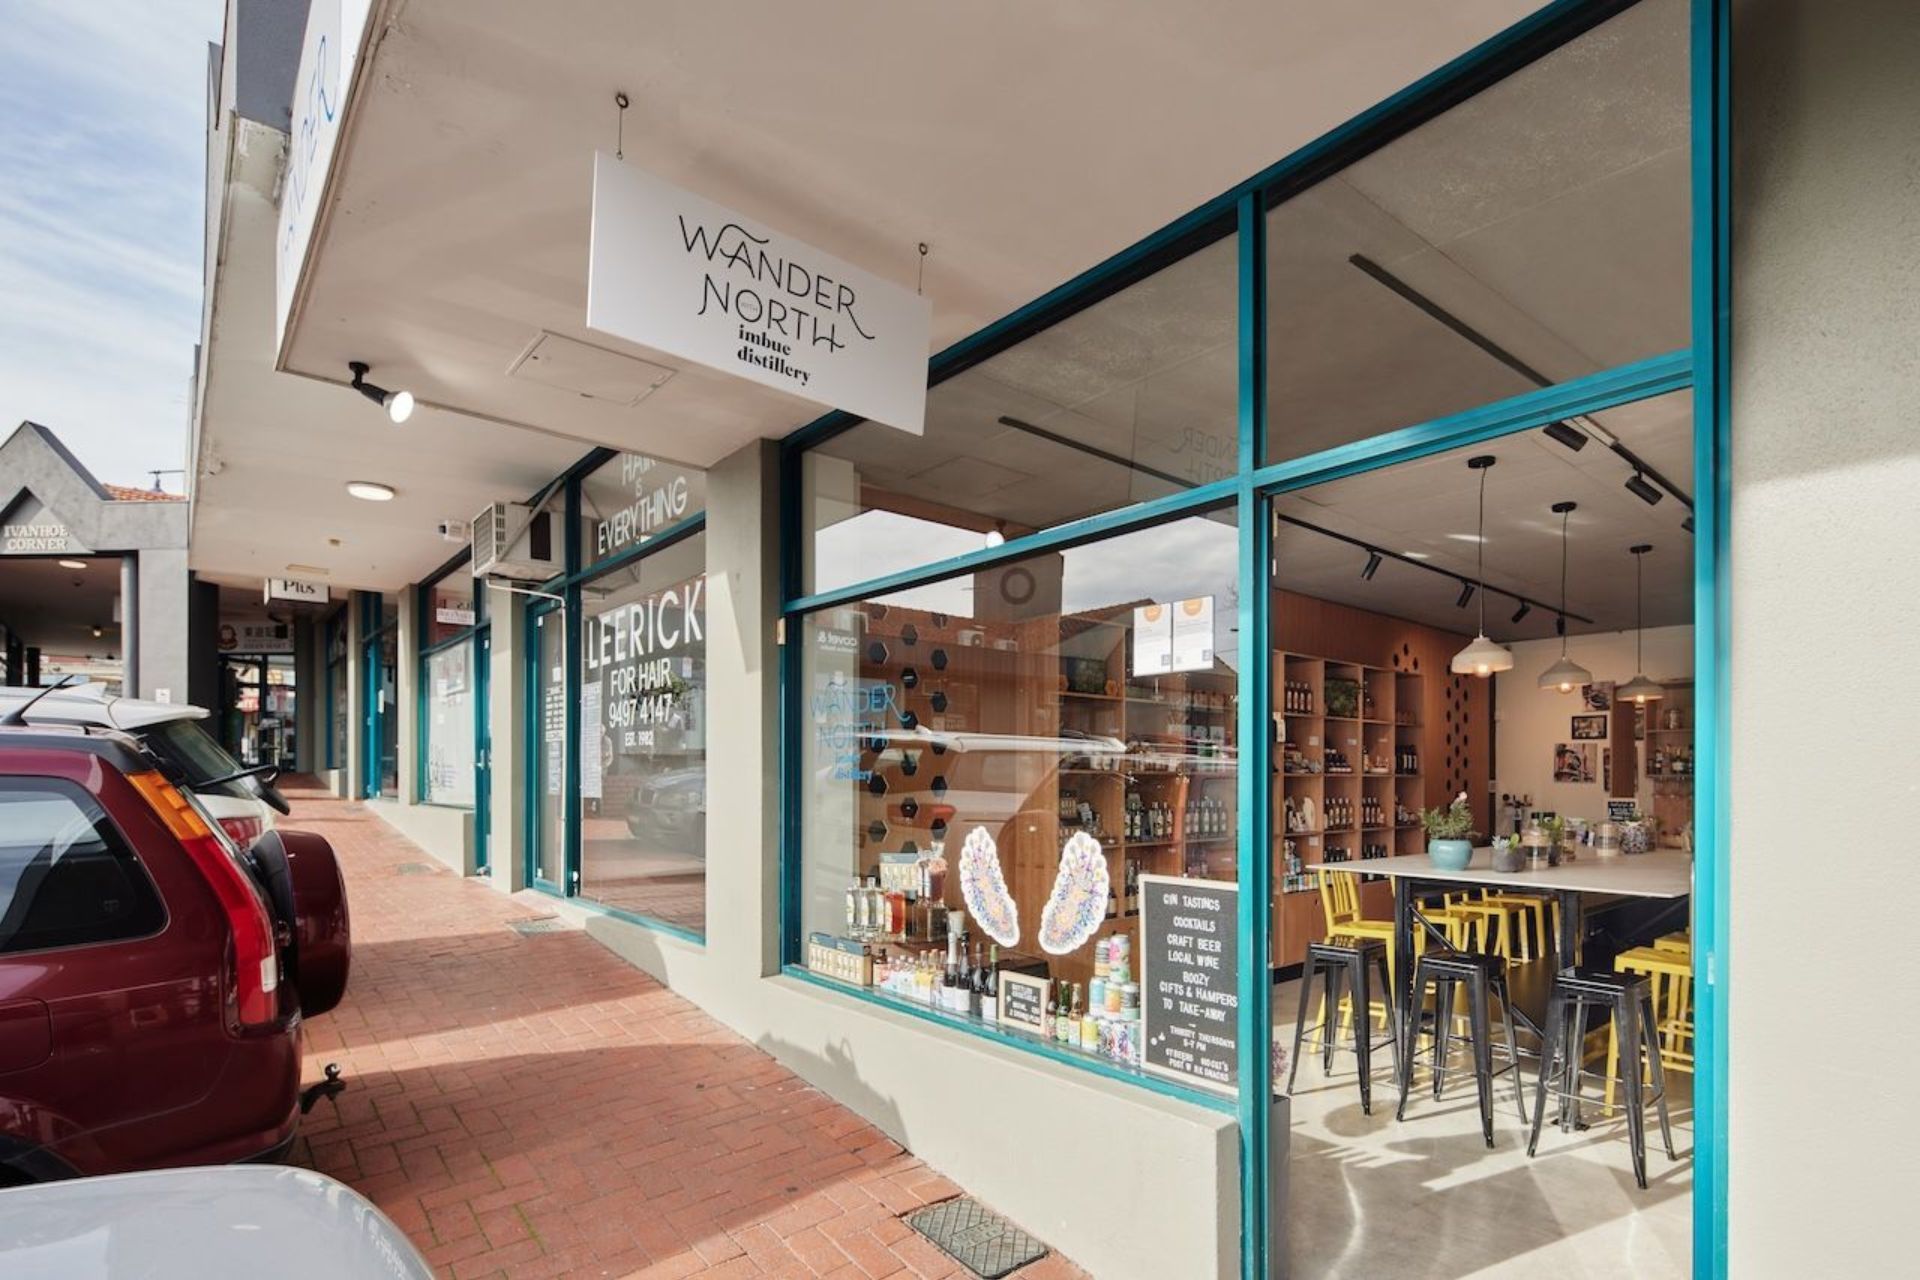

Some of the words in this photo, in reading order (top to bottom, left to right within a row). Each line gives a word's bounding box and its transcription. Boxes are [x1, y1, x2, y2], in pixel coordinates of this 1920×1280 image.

[679, 215, 875, 340] WANDER
[698, 273, 845, 353] NORTH
[738, 324, 791, 356] imbue
[737, 346, 811, 386] distillery
[598, 476, 688, 555] EVERYTHING
[4, 525, 70, 538] IVANHOE
[8, 538, 67, 550] CORNER
[283, 580, 315, 594] Plus
[589, 580, 703, 669] LEERICK
[611, 666, 636, 697] FOR
[639, 657, 672, 691] HAIR
[609, 700, 637, 728] 9497
[640, 693, 673, 725] 4147
[625, 732, 636, 746] EST.
[1163, 893, 1178, 905] GIN
[1182, 895, 1221, 911] TASTINGS
[1173, 916, 1216, 932] COCKTAILS
[1167, 933, 1193, 948] CRAFT
[1198, 938, 1221, 952] BEER
[1168, 950, 1194, 965] LOCAL
[1197, 954, 1220, 970] WINE
[1183, 971, 1210, 987] BOOZY
[1160, 980, 1184, 996] GIFTS
[1186, 986, 1193, 998] &
[1195, 987, 1238, 1008] HAMPERS
[1163, 997, 1173, 1010] TO
[1179, 1001, 1226, 1022] TAKE-AWAY
